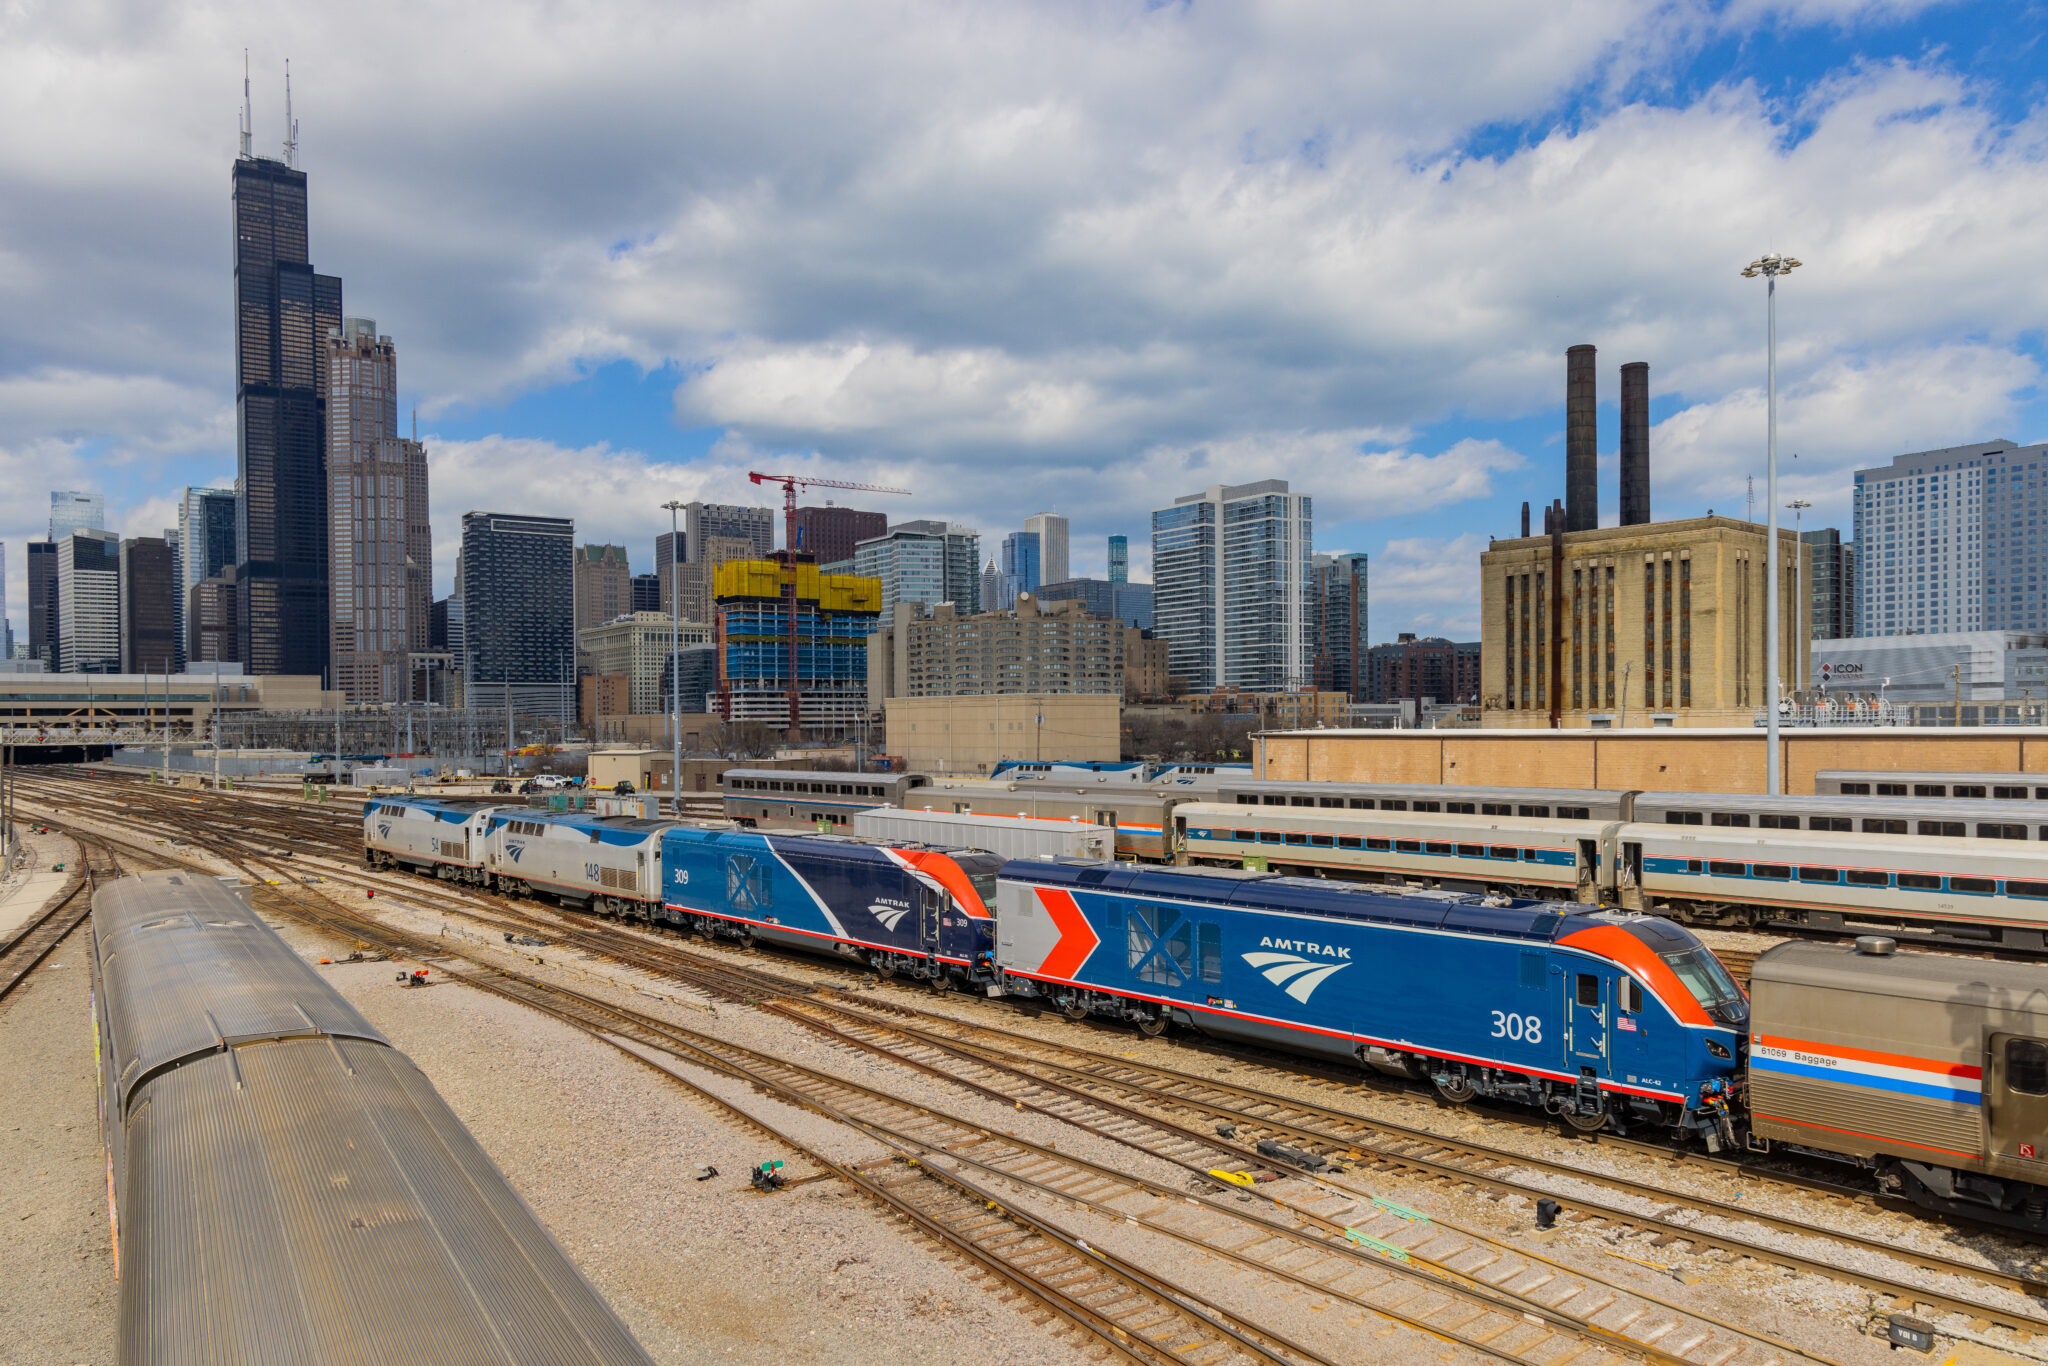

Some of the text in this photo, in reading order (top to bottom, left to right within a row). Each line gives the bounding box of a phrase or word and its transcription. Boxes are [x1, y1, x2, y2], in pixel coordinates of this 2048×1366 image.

[1834, 663, 1863, 673] ICON
[431, 837, 439, 853] 54
[584, 862, 600, 882] 148
[674, 868, 689, 885] 309
[875, 897, 910, 908] AMTRAK
[956, 918, 968, 927] 309
[1260, 936, 1352, 960] AMTRAK
[1490, 1010, 1543, 1044] 308
[1794, 1052, 1837, 1067] Baggage
